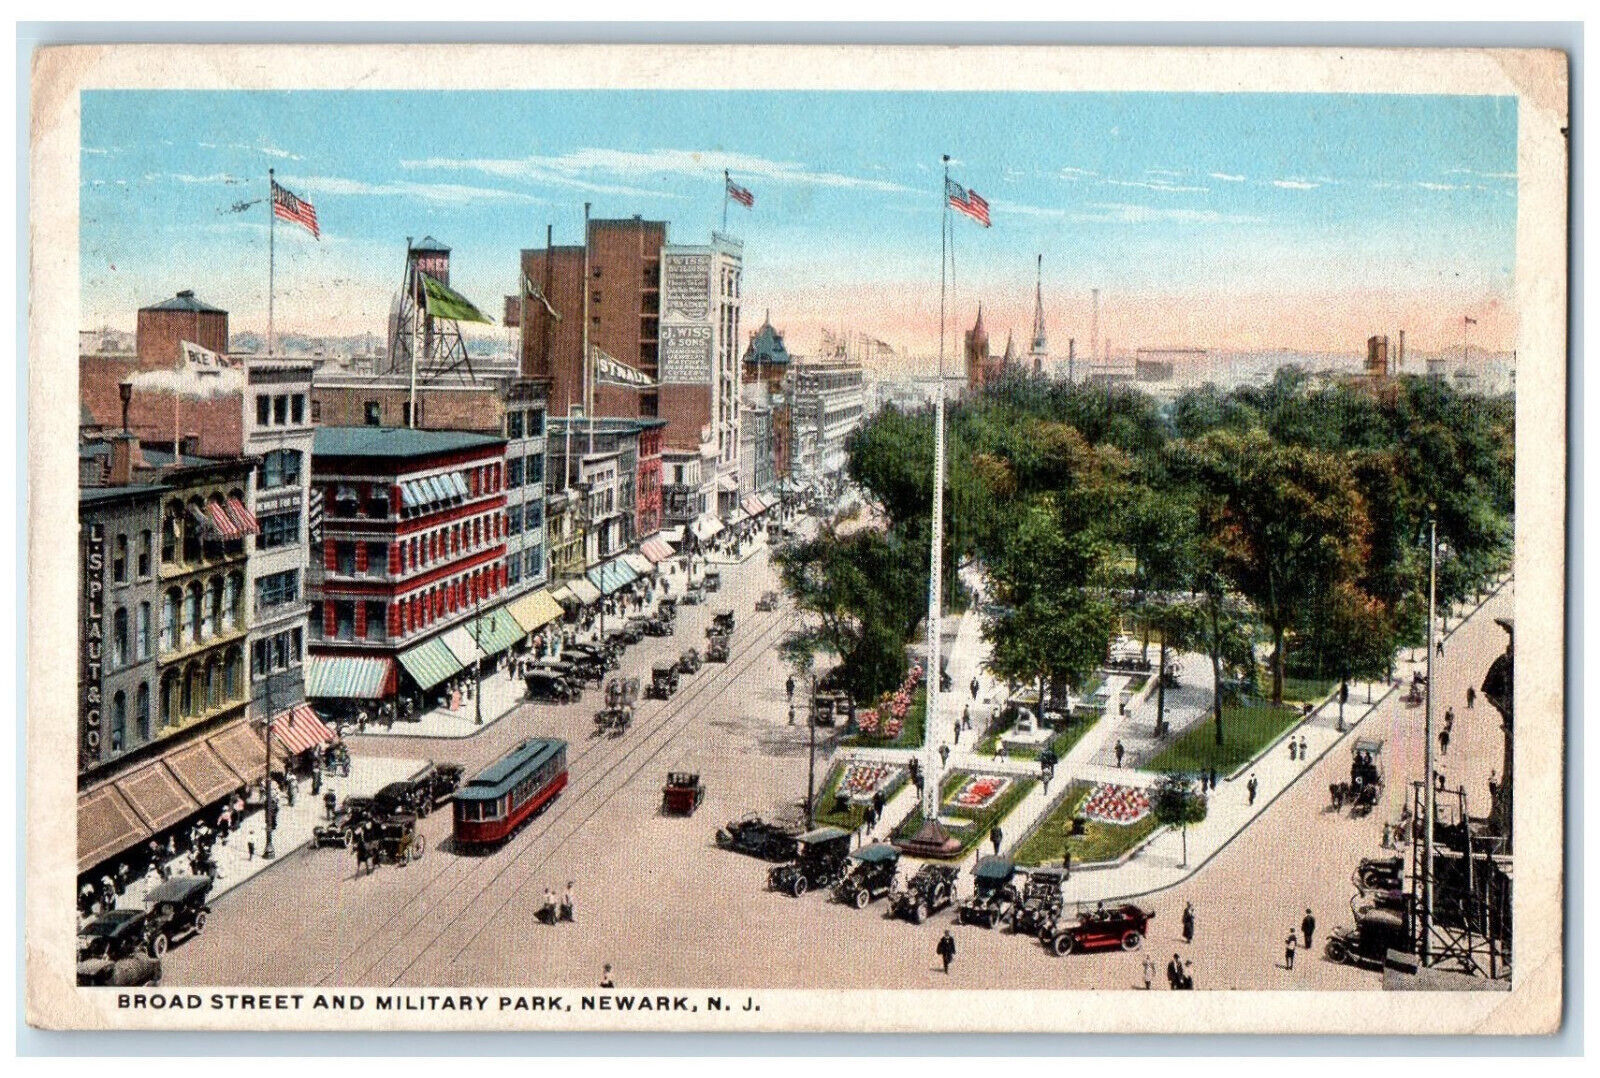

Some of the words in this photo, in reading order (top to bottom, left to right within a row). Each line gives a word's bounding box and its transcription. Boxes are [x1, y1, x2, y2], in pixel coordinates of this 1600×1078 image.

[677, 327, 712, 340] WISS
[667, 339, 676, 347] &
[118, 994, 202, 1009] BROAD
[211, 994, 303, 1009] STREET
[313, 994, 365, 1009] AND
[376, 995, 487, 1010] MILITARY
[499, 996, 571, 1011] PARK,
[581, 996, 698, 1012] NEWARK,
[707, 996, 730, 1010] N.
[742, 997, 760, 1010] J.
